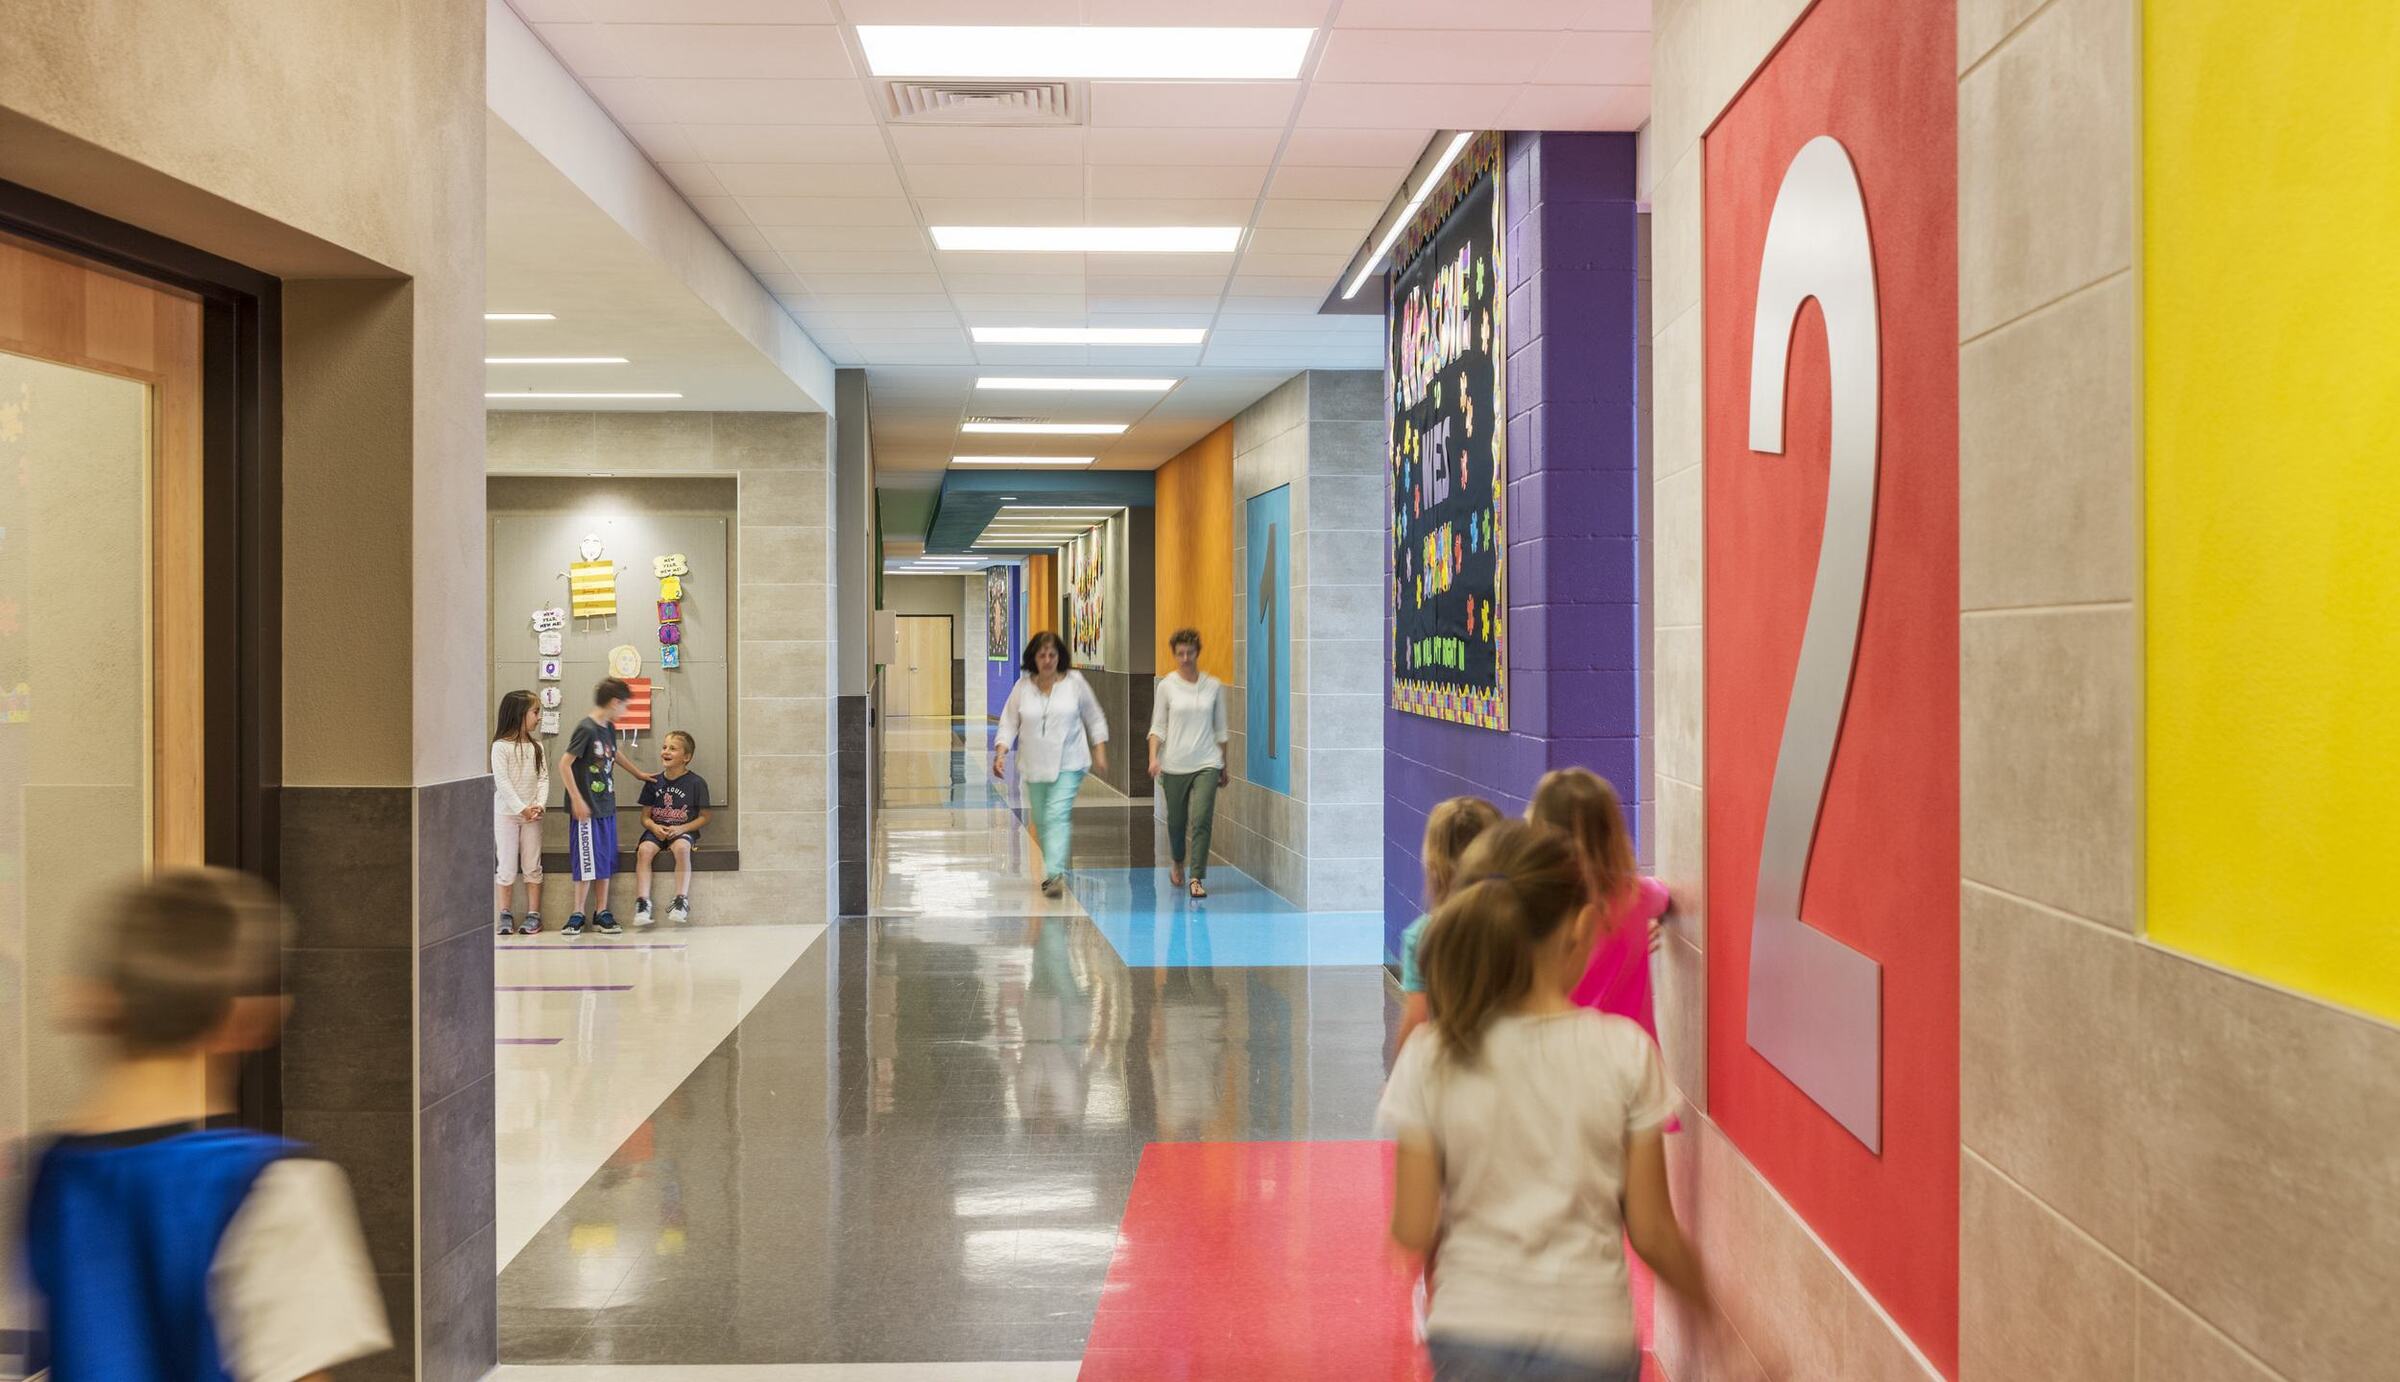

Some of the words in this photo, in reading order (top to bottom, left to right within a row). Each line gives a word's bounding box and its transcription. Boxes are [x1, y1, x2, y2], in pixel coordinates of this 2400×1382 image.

[1422, 416, 1450, 510] WES
[1259, 522, 1277, 760] 1
[1747, 135, 1883, 1155] 2
